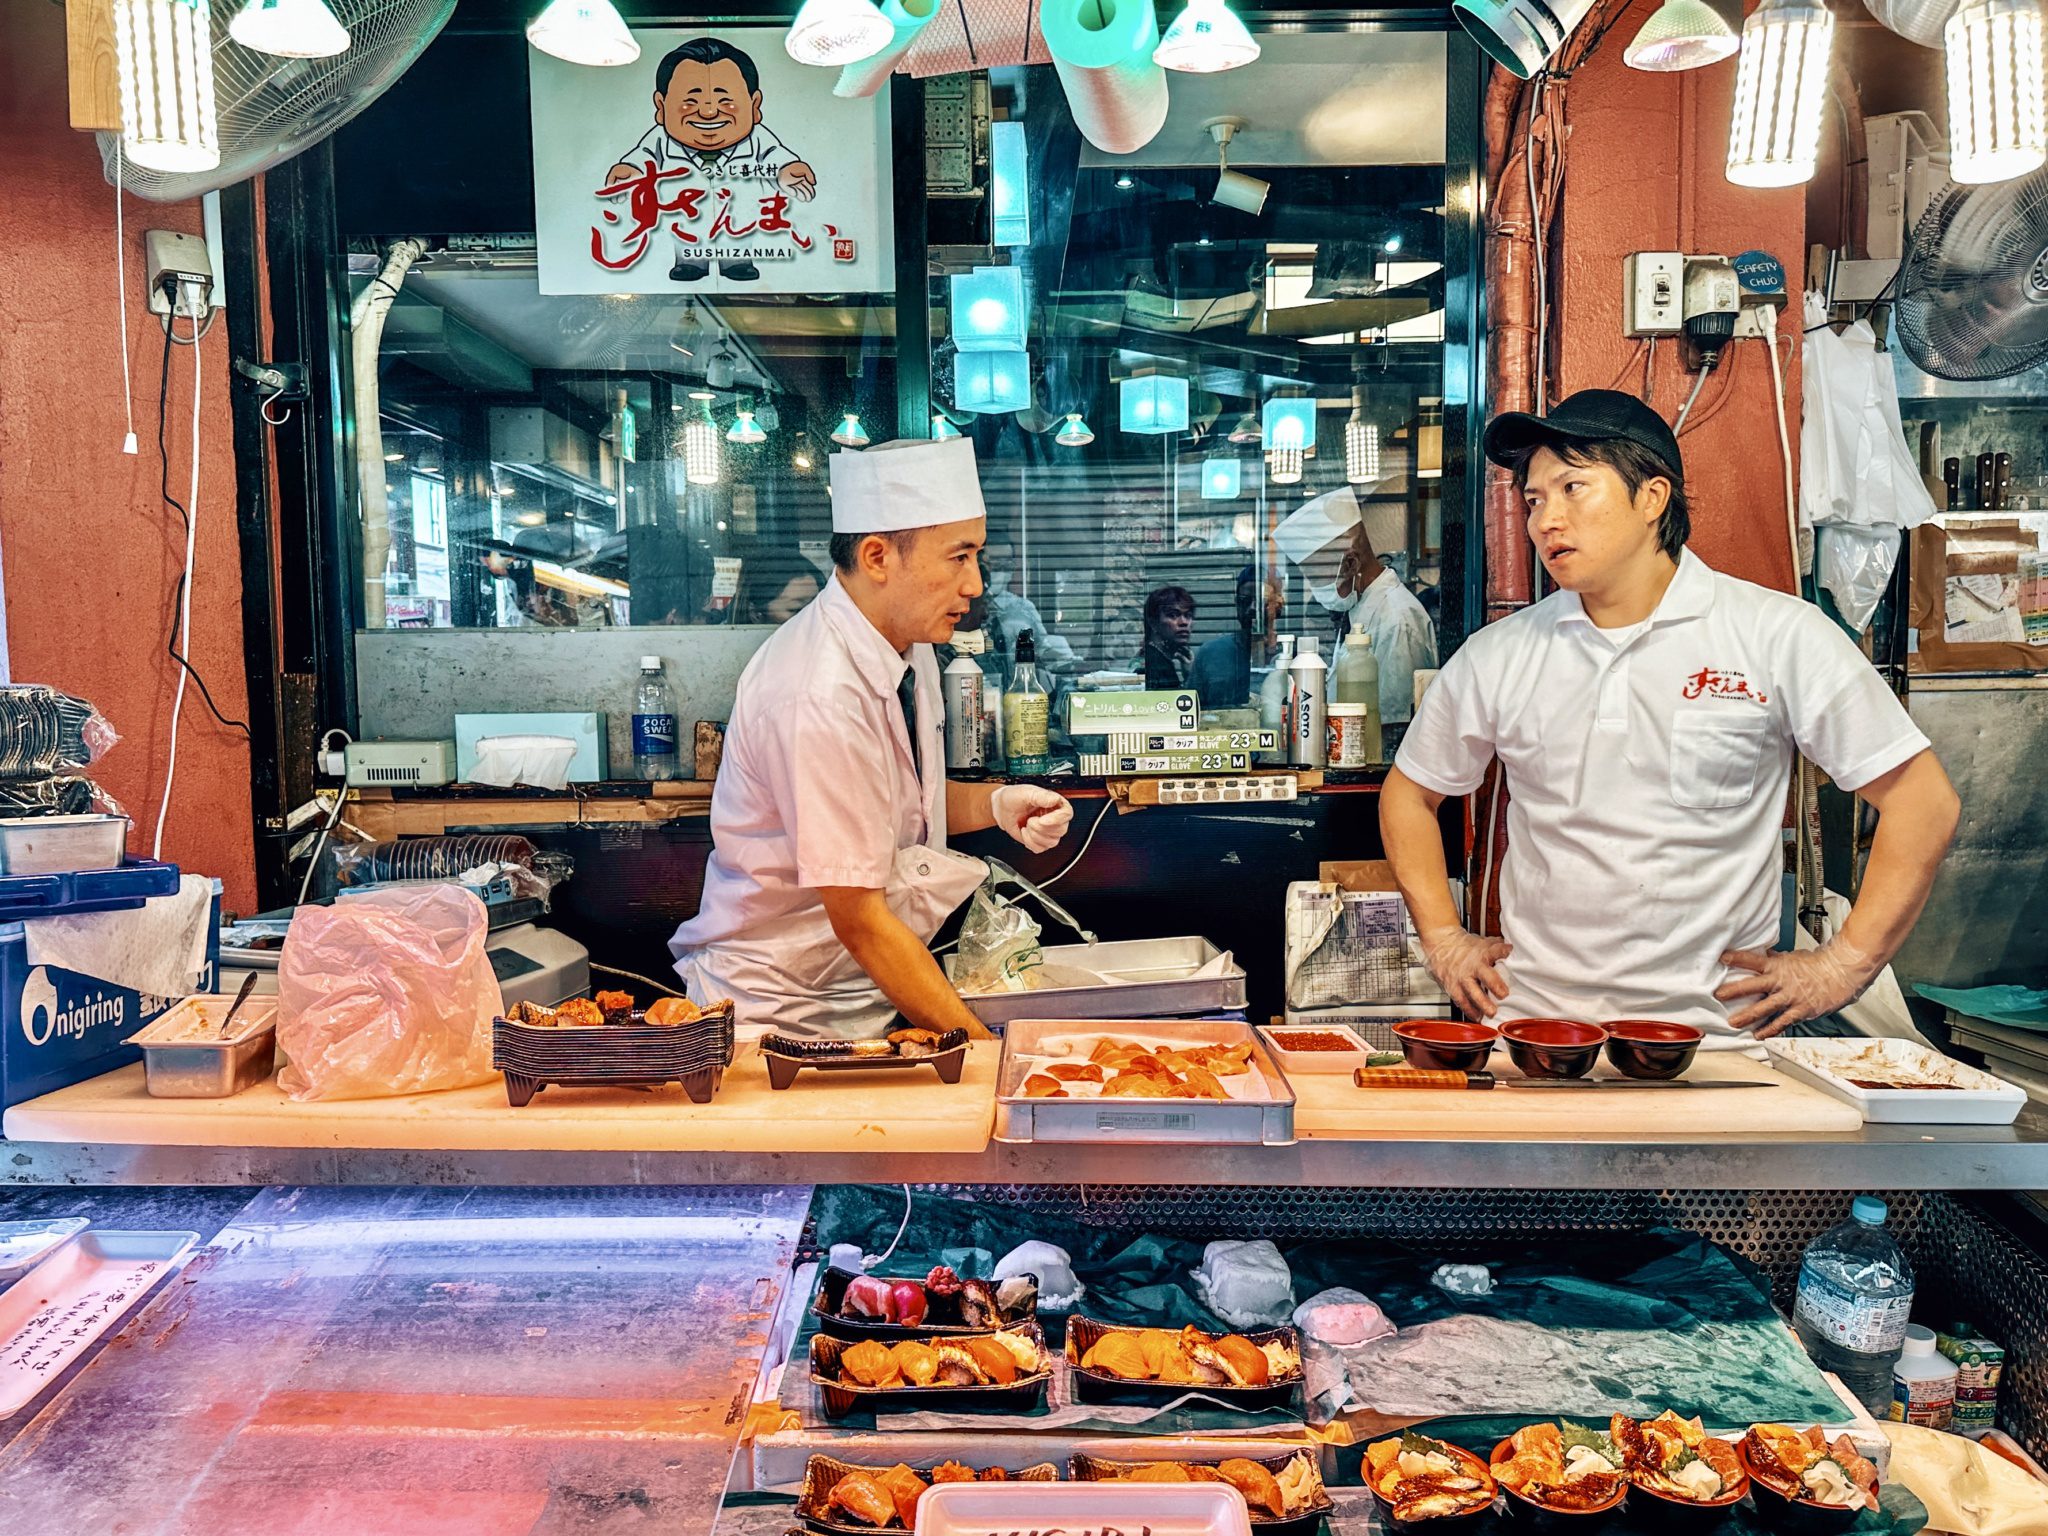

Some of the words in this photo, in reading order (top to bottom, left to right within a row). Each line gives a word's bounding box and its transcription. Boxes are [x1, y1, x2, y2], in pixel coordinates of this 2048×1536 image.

[701, 164, 778, 177] つきじ喜代村
[684, 248, 791, 258] SUSHIZANMAI
[1737, 262, 1777, 274] SAFETY
[642, 719, 673, 727] POCA
[1182, 716, 1193, 725] M
[1301, 704, 1309, 739] SOTO
[1176, 740, 1193, 748] クリア
[1261, 735, 1273, 746] M
[1147, 761, 1165, 769] クリア
[1171, 762, 1191, 770] GLOVE
[1233, 756, 1244, 767] M
[21, 965, 124, 1046] Onigiring
